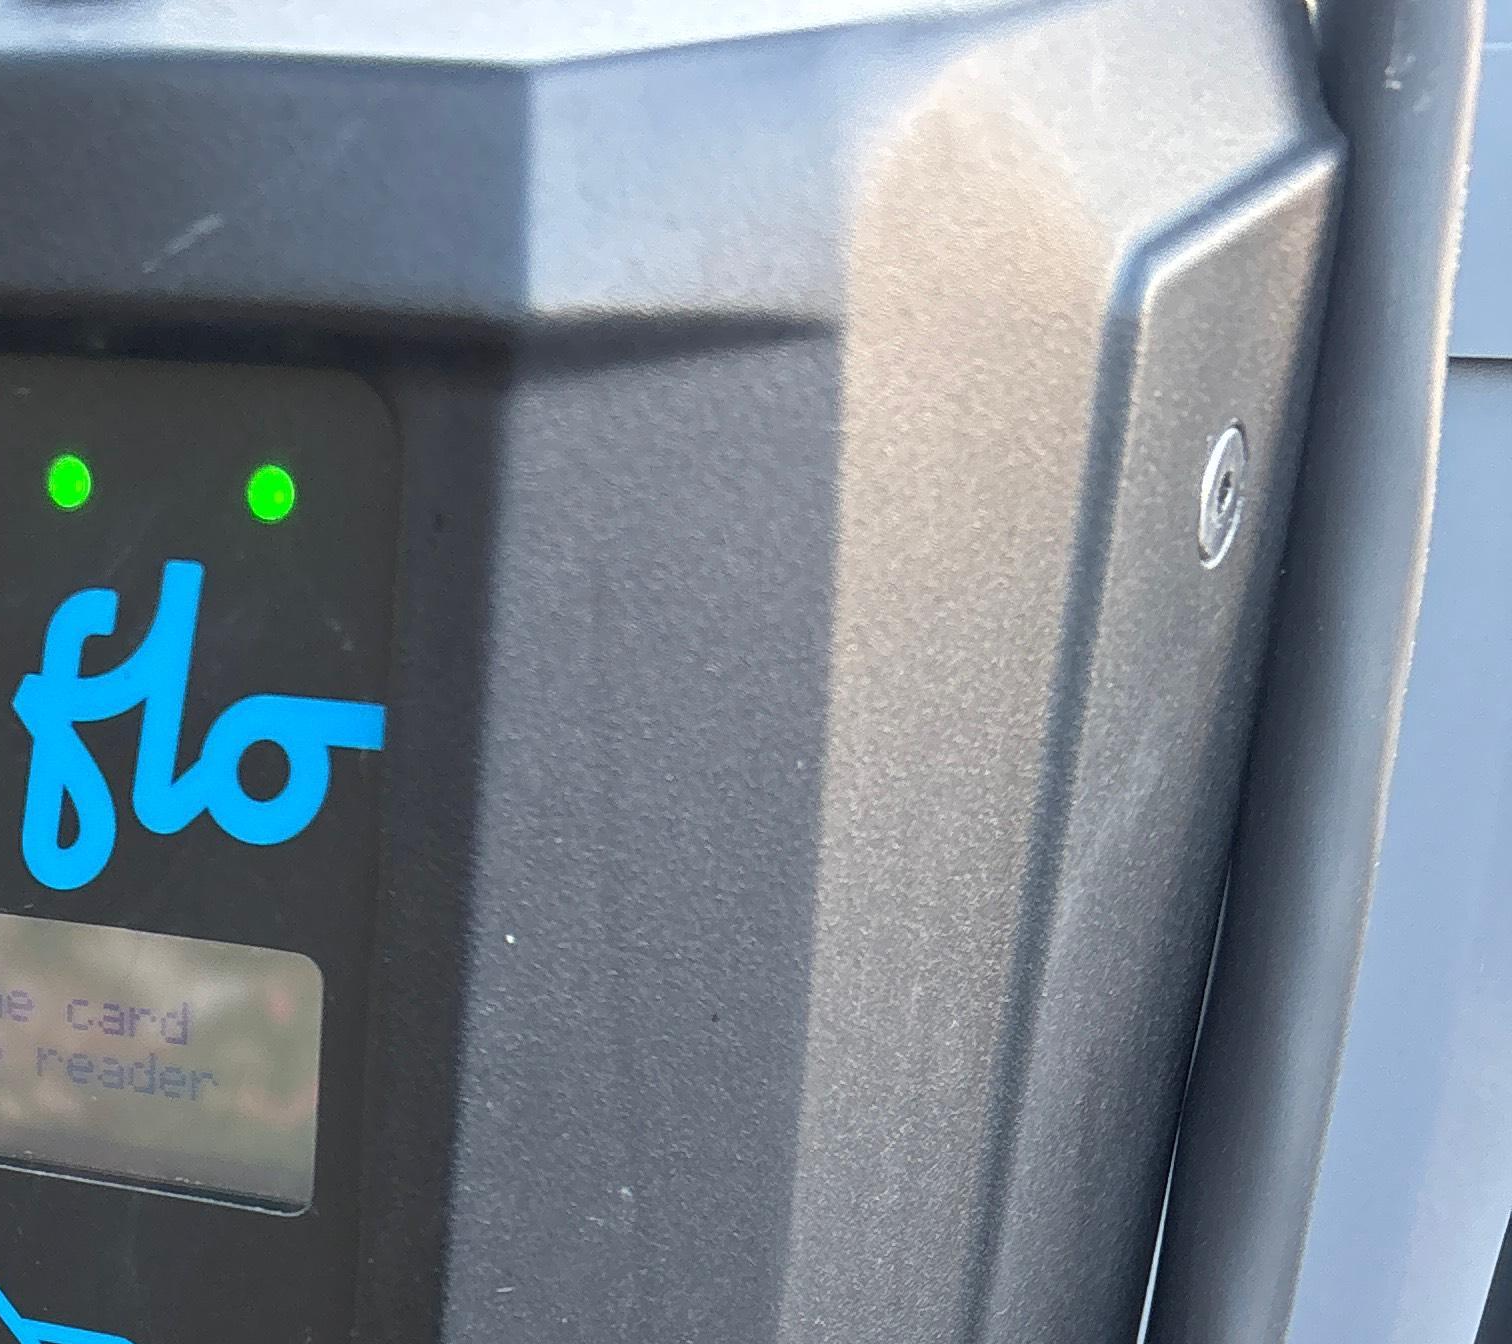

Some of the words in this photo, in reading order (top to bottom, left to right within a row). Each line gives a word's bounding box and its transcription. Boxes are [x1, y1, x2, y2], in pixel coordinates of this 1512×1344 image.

[11, 559, 387, 890] flo
[65, 998, 189, 1047] card
[36, 1046, 219, 1100] reader
